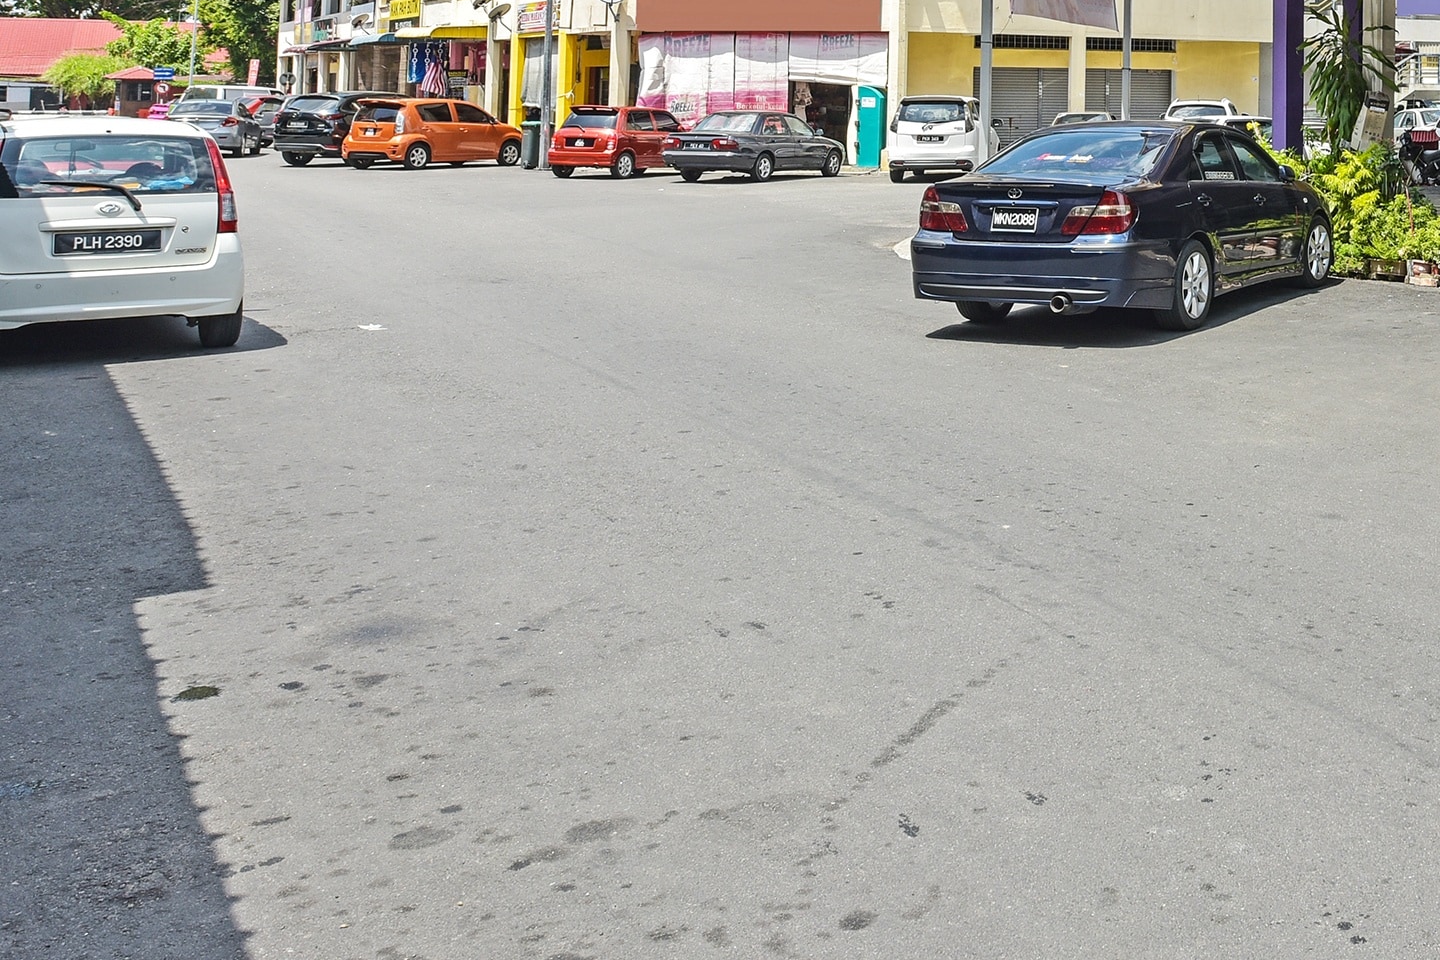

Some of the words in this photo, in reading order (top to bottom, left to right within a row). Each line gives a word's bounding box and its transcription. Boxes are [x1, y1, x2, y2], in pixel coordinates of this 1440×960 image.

[994, 211, 1036, 226] WKN2088
[73, 234, 102, 251] PLH
[105, 234, 143, 249] 2390
